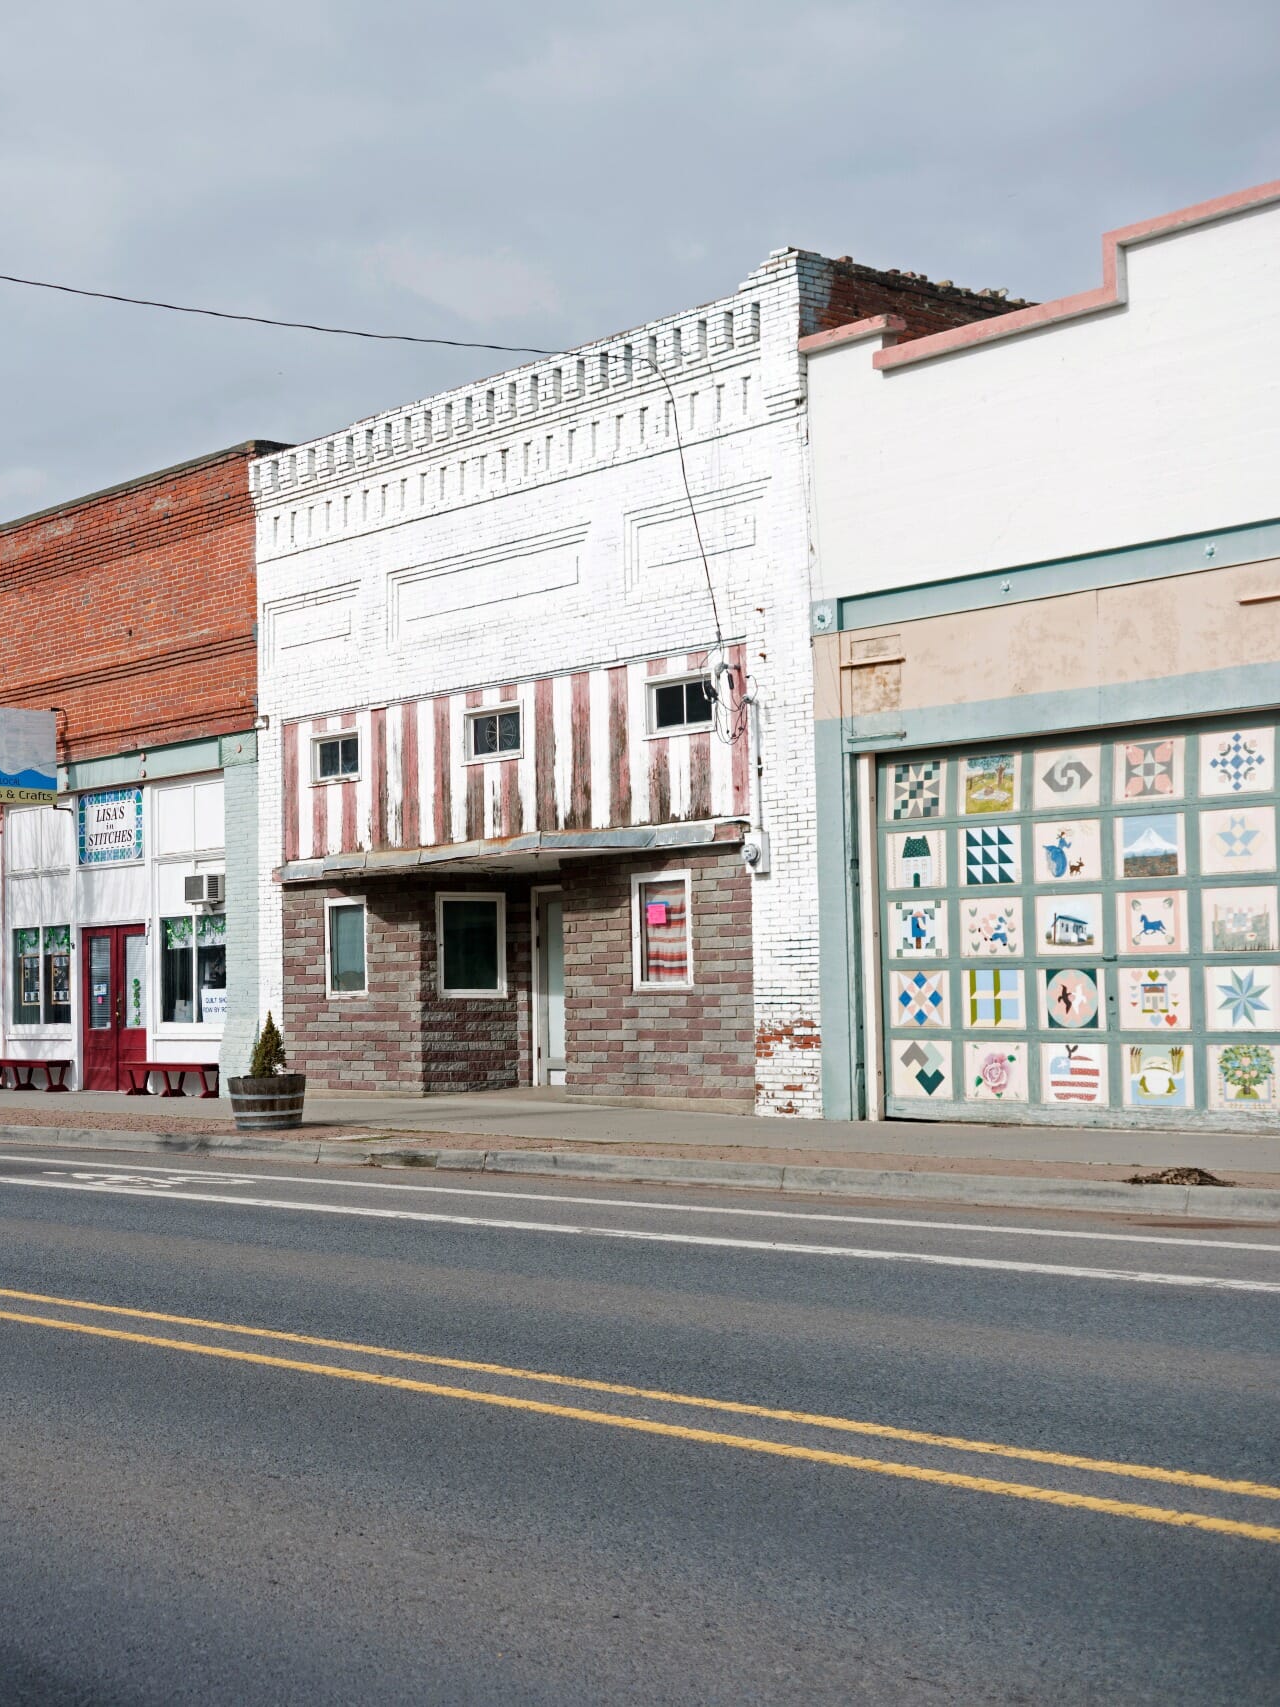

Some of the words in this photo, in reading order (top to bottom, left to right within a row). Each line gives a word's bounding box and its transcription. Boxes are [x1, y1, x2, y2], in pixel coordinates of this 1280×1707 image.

[0, 777, 21, 786] LOCAL
[6, 789, 15, 799] &
[19, 790, 53, 801] Crafts
[106, 822, 114, 830] in
[88, 829, 133, 847] STITCHES
